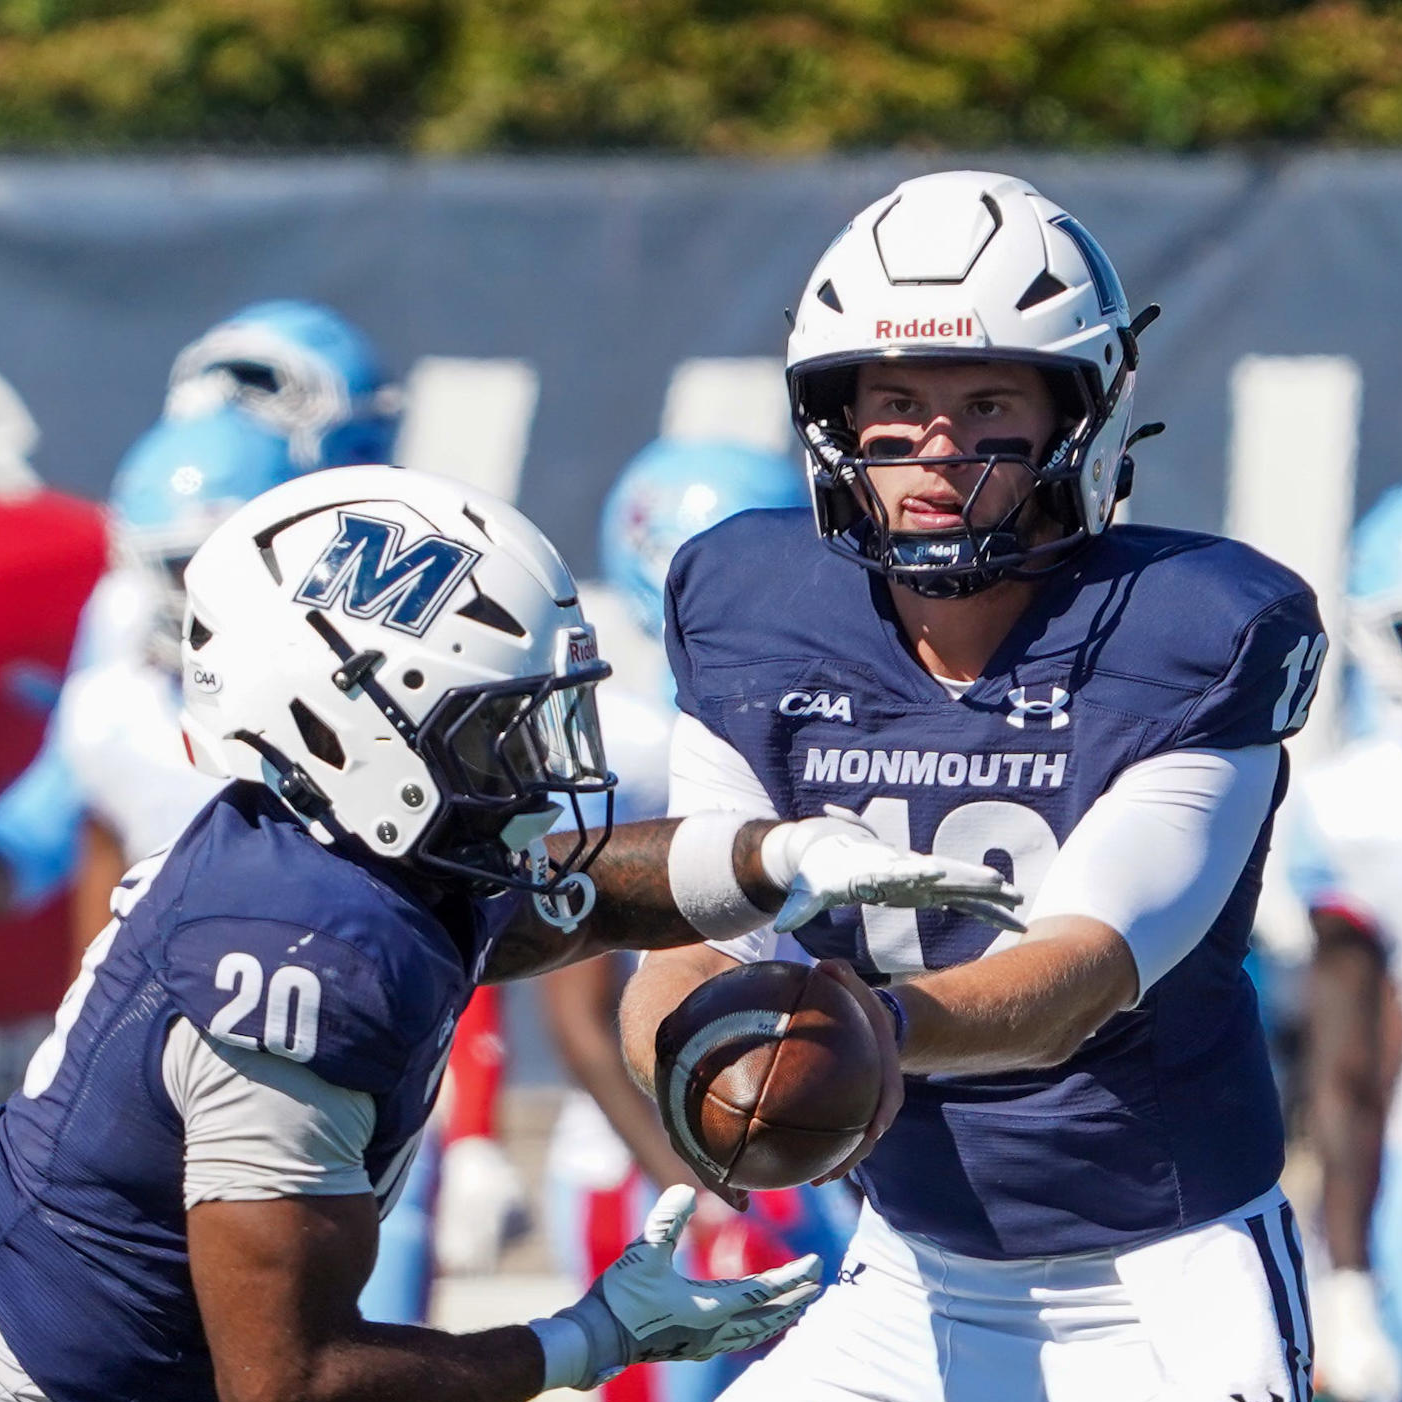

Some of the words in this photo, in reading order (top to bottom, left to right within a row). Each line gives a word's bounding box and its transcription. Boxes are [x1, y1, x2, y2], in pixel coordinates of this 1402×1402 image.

[875, 317, 973, 340] Riddell
[294, 510, 485, 639] M
[194, 669, 217, 687] CAA
[1271, 631, 1330, 732] 12
[778, 688, 854, 723] CAA
[802, 747, 1069, 789] MONMOUTH
[206, 951, 322, 1064] 20
